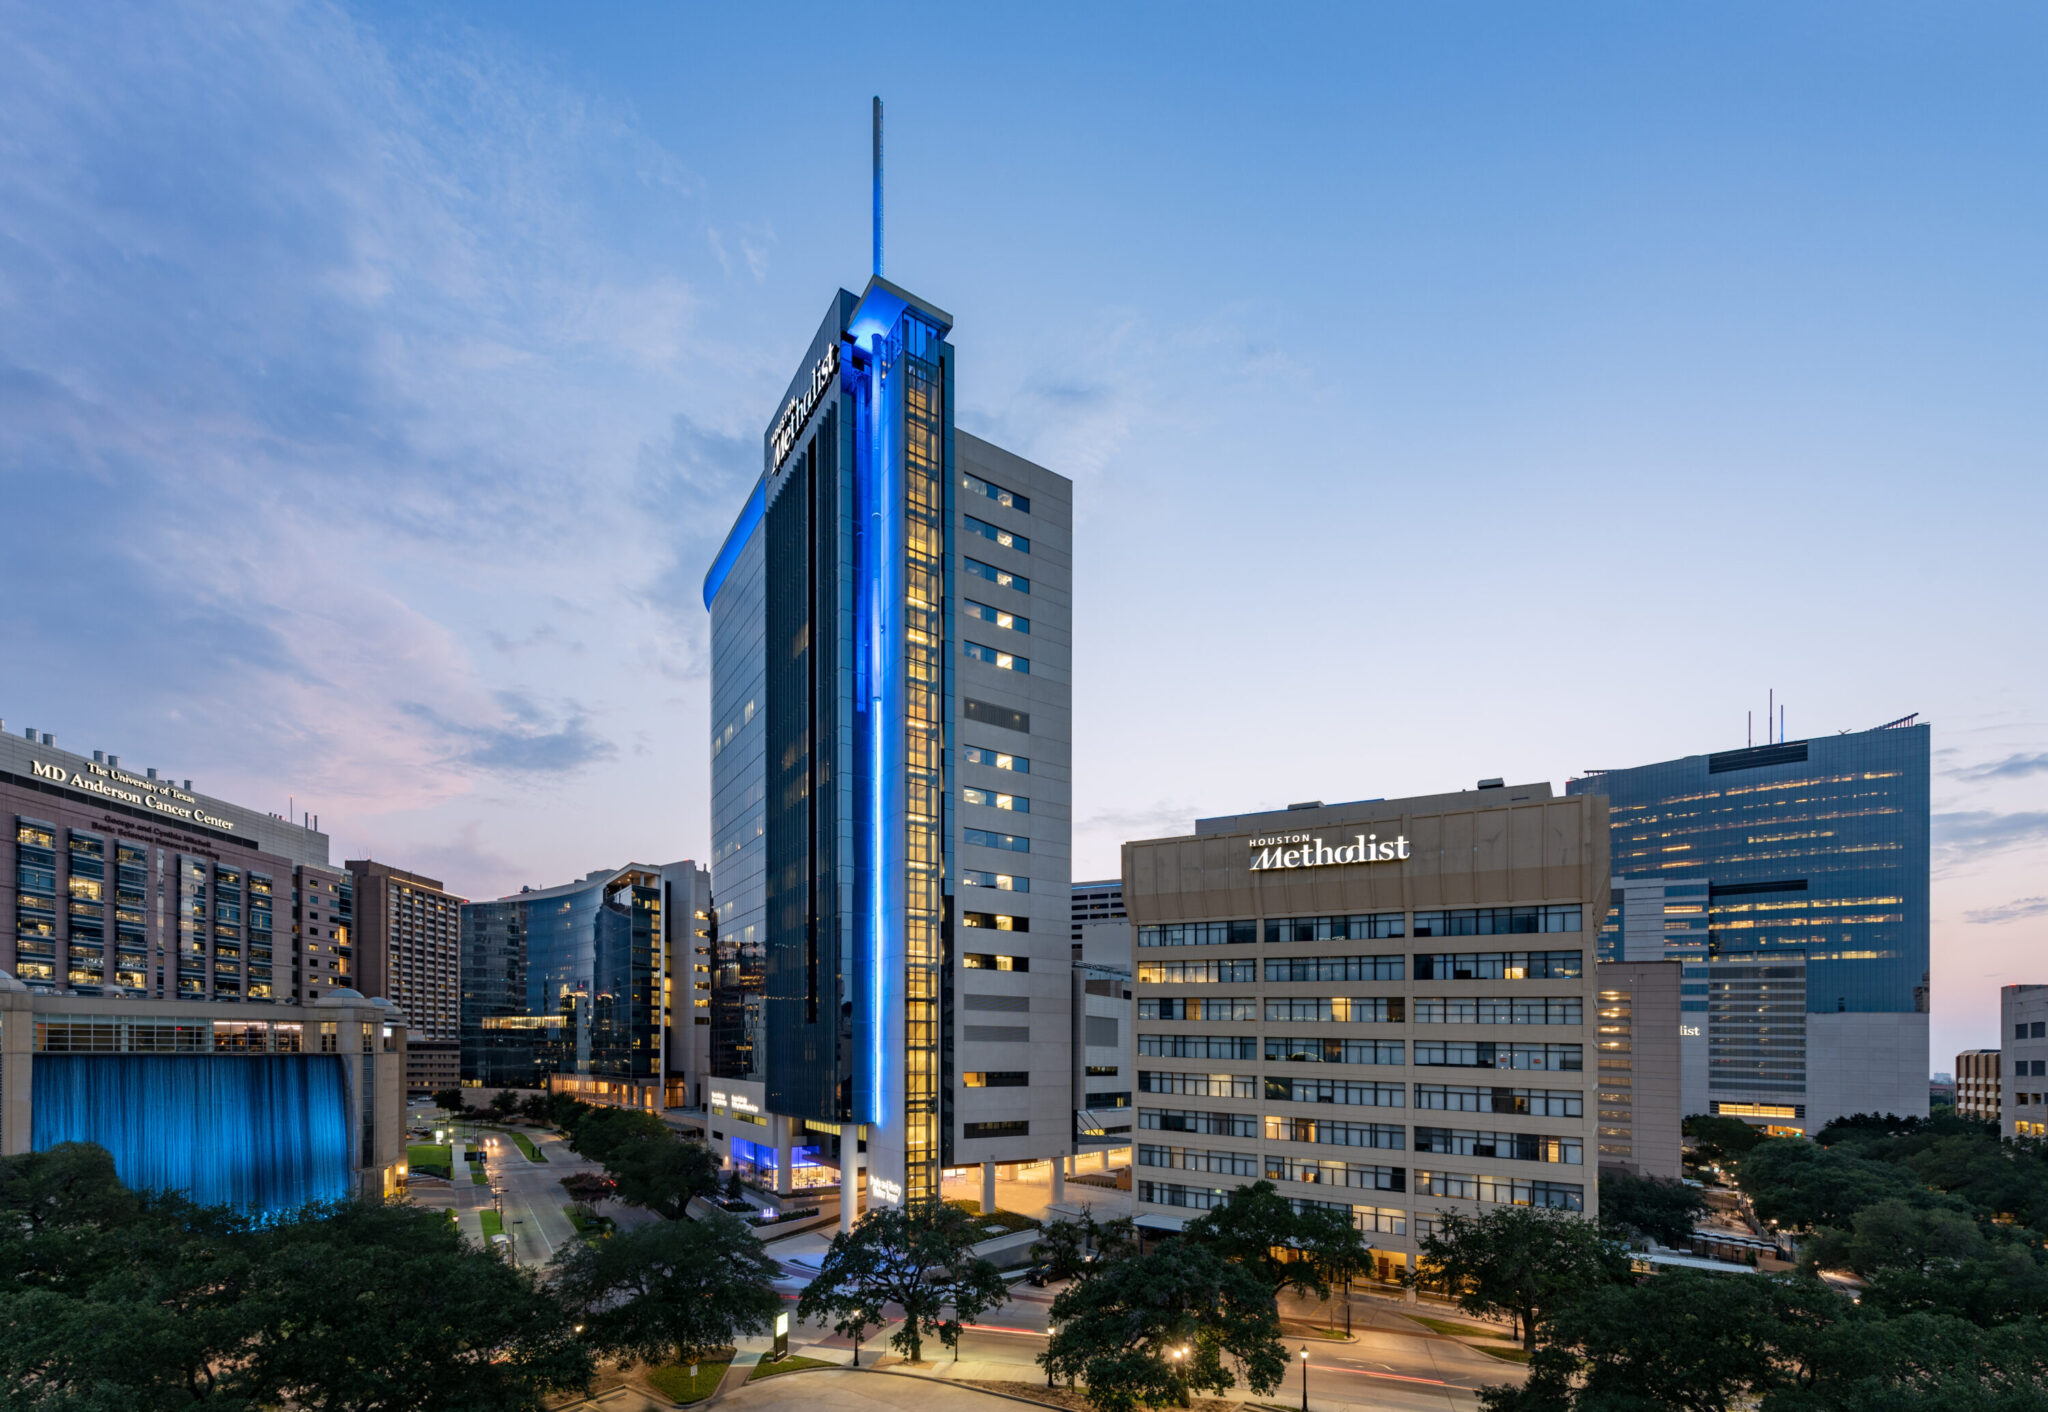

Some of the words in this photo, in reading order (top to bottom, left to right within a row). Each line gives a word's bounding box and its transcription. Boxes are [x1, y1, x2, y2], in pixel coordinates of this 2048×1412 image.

[771, 342, 836, 475] Methodist
[771, 395, 797, 447] HOUSTON
[32, 760, 67, 782] MD
[70, 773, 142, 804] Anderson
[145, 795, 191, 818] Cancer
[193, 809, 234, 830] Center
[87, 762, 108, 777] The
[110, 769, 158, 793] University
[160, 787, 170, 796] of
[171, 788, 196, 804] Texas
[104, 815, 135, 830] George
[136, 824, 152, 834] and
[1249, 834, 1310, 847] HOUSTON
[1249, 833, 1410, 871] Methodist
